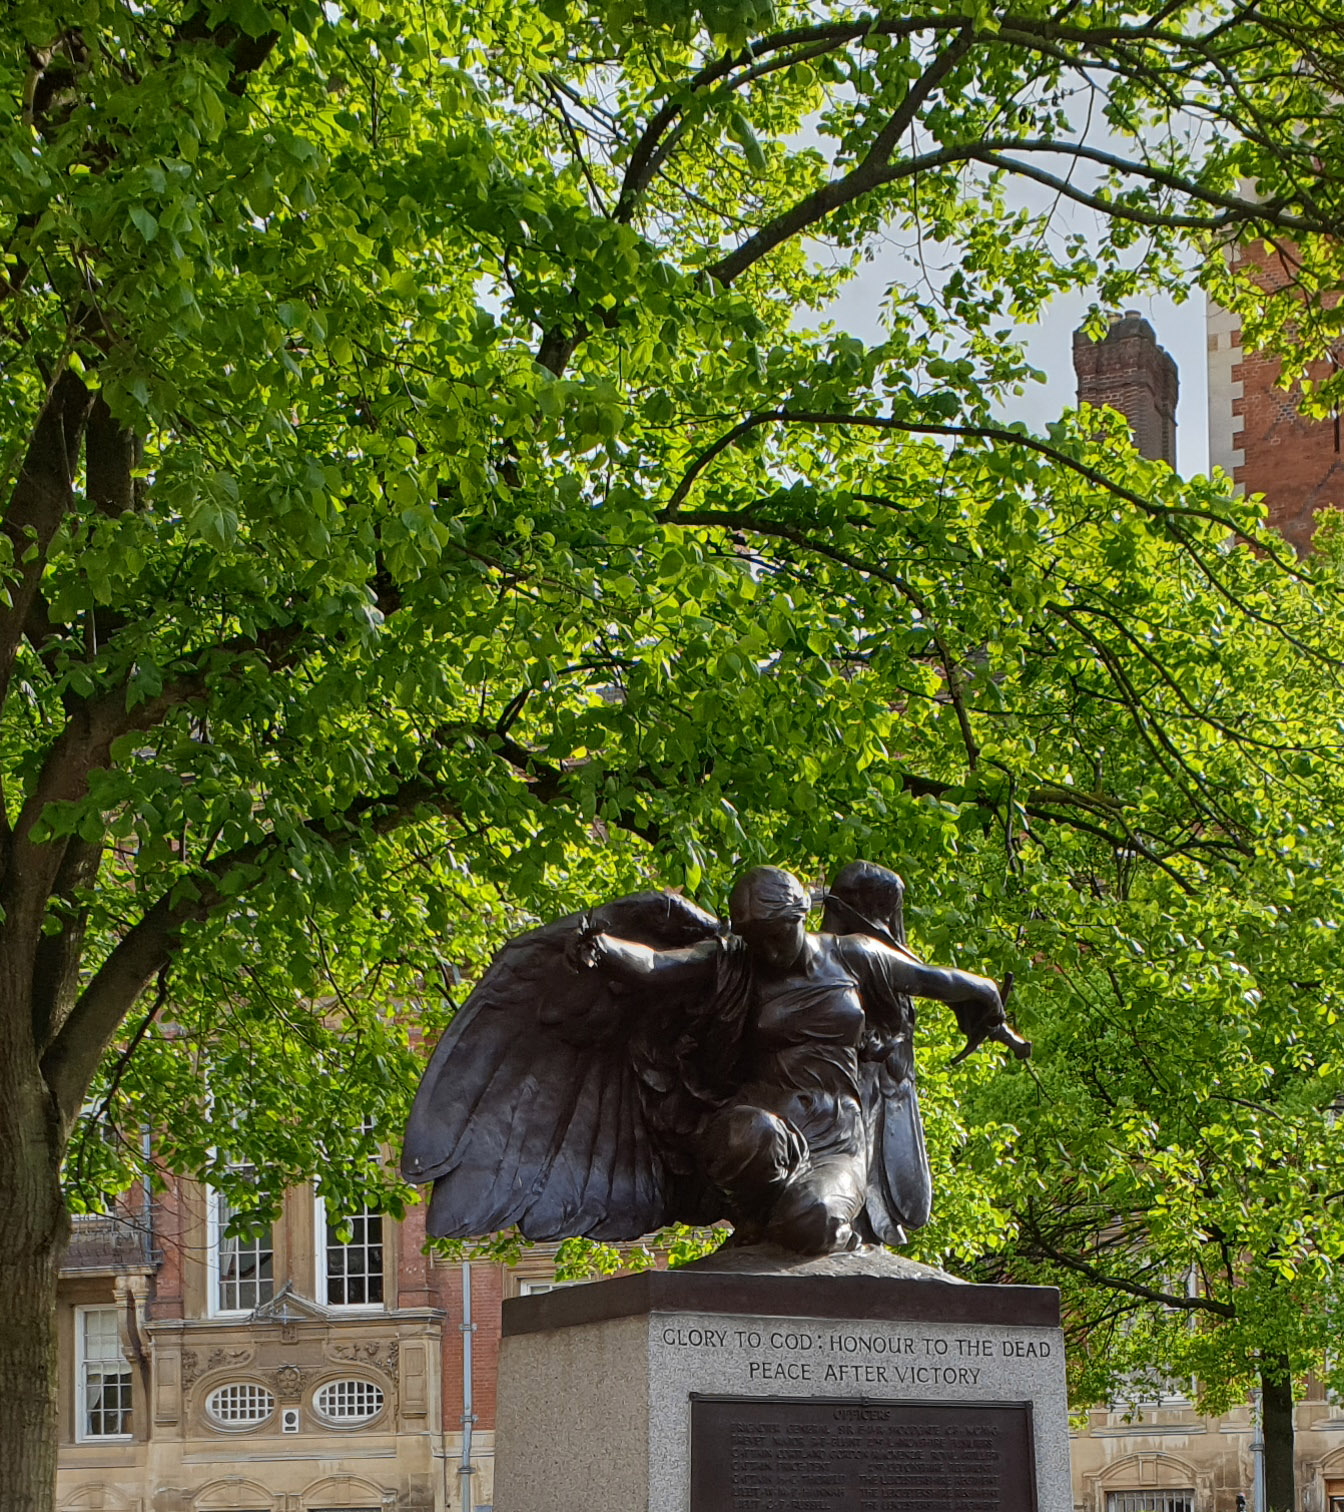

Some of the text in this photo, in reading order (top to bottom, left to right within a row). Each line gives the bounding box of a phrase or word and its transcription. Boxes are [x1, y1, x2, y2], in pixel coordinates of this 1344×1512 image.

[662, 1327, 728, 1348] GLORY
[733, 1331, 762, 1349] TO
[829, 1335, 917, 1355] HONOUR
[922, 1338, 949, 1356] TO
[955, 1338, 994, 1358] THE
[1001, 1340, 1052, 1359] DEAD
[748, 1361, 982, 1385] PEACE AFTER VICTORY
[833, 1408, 891, 1422] OFFICERS
